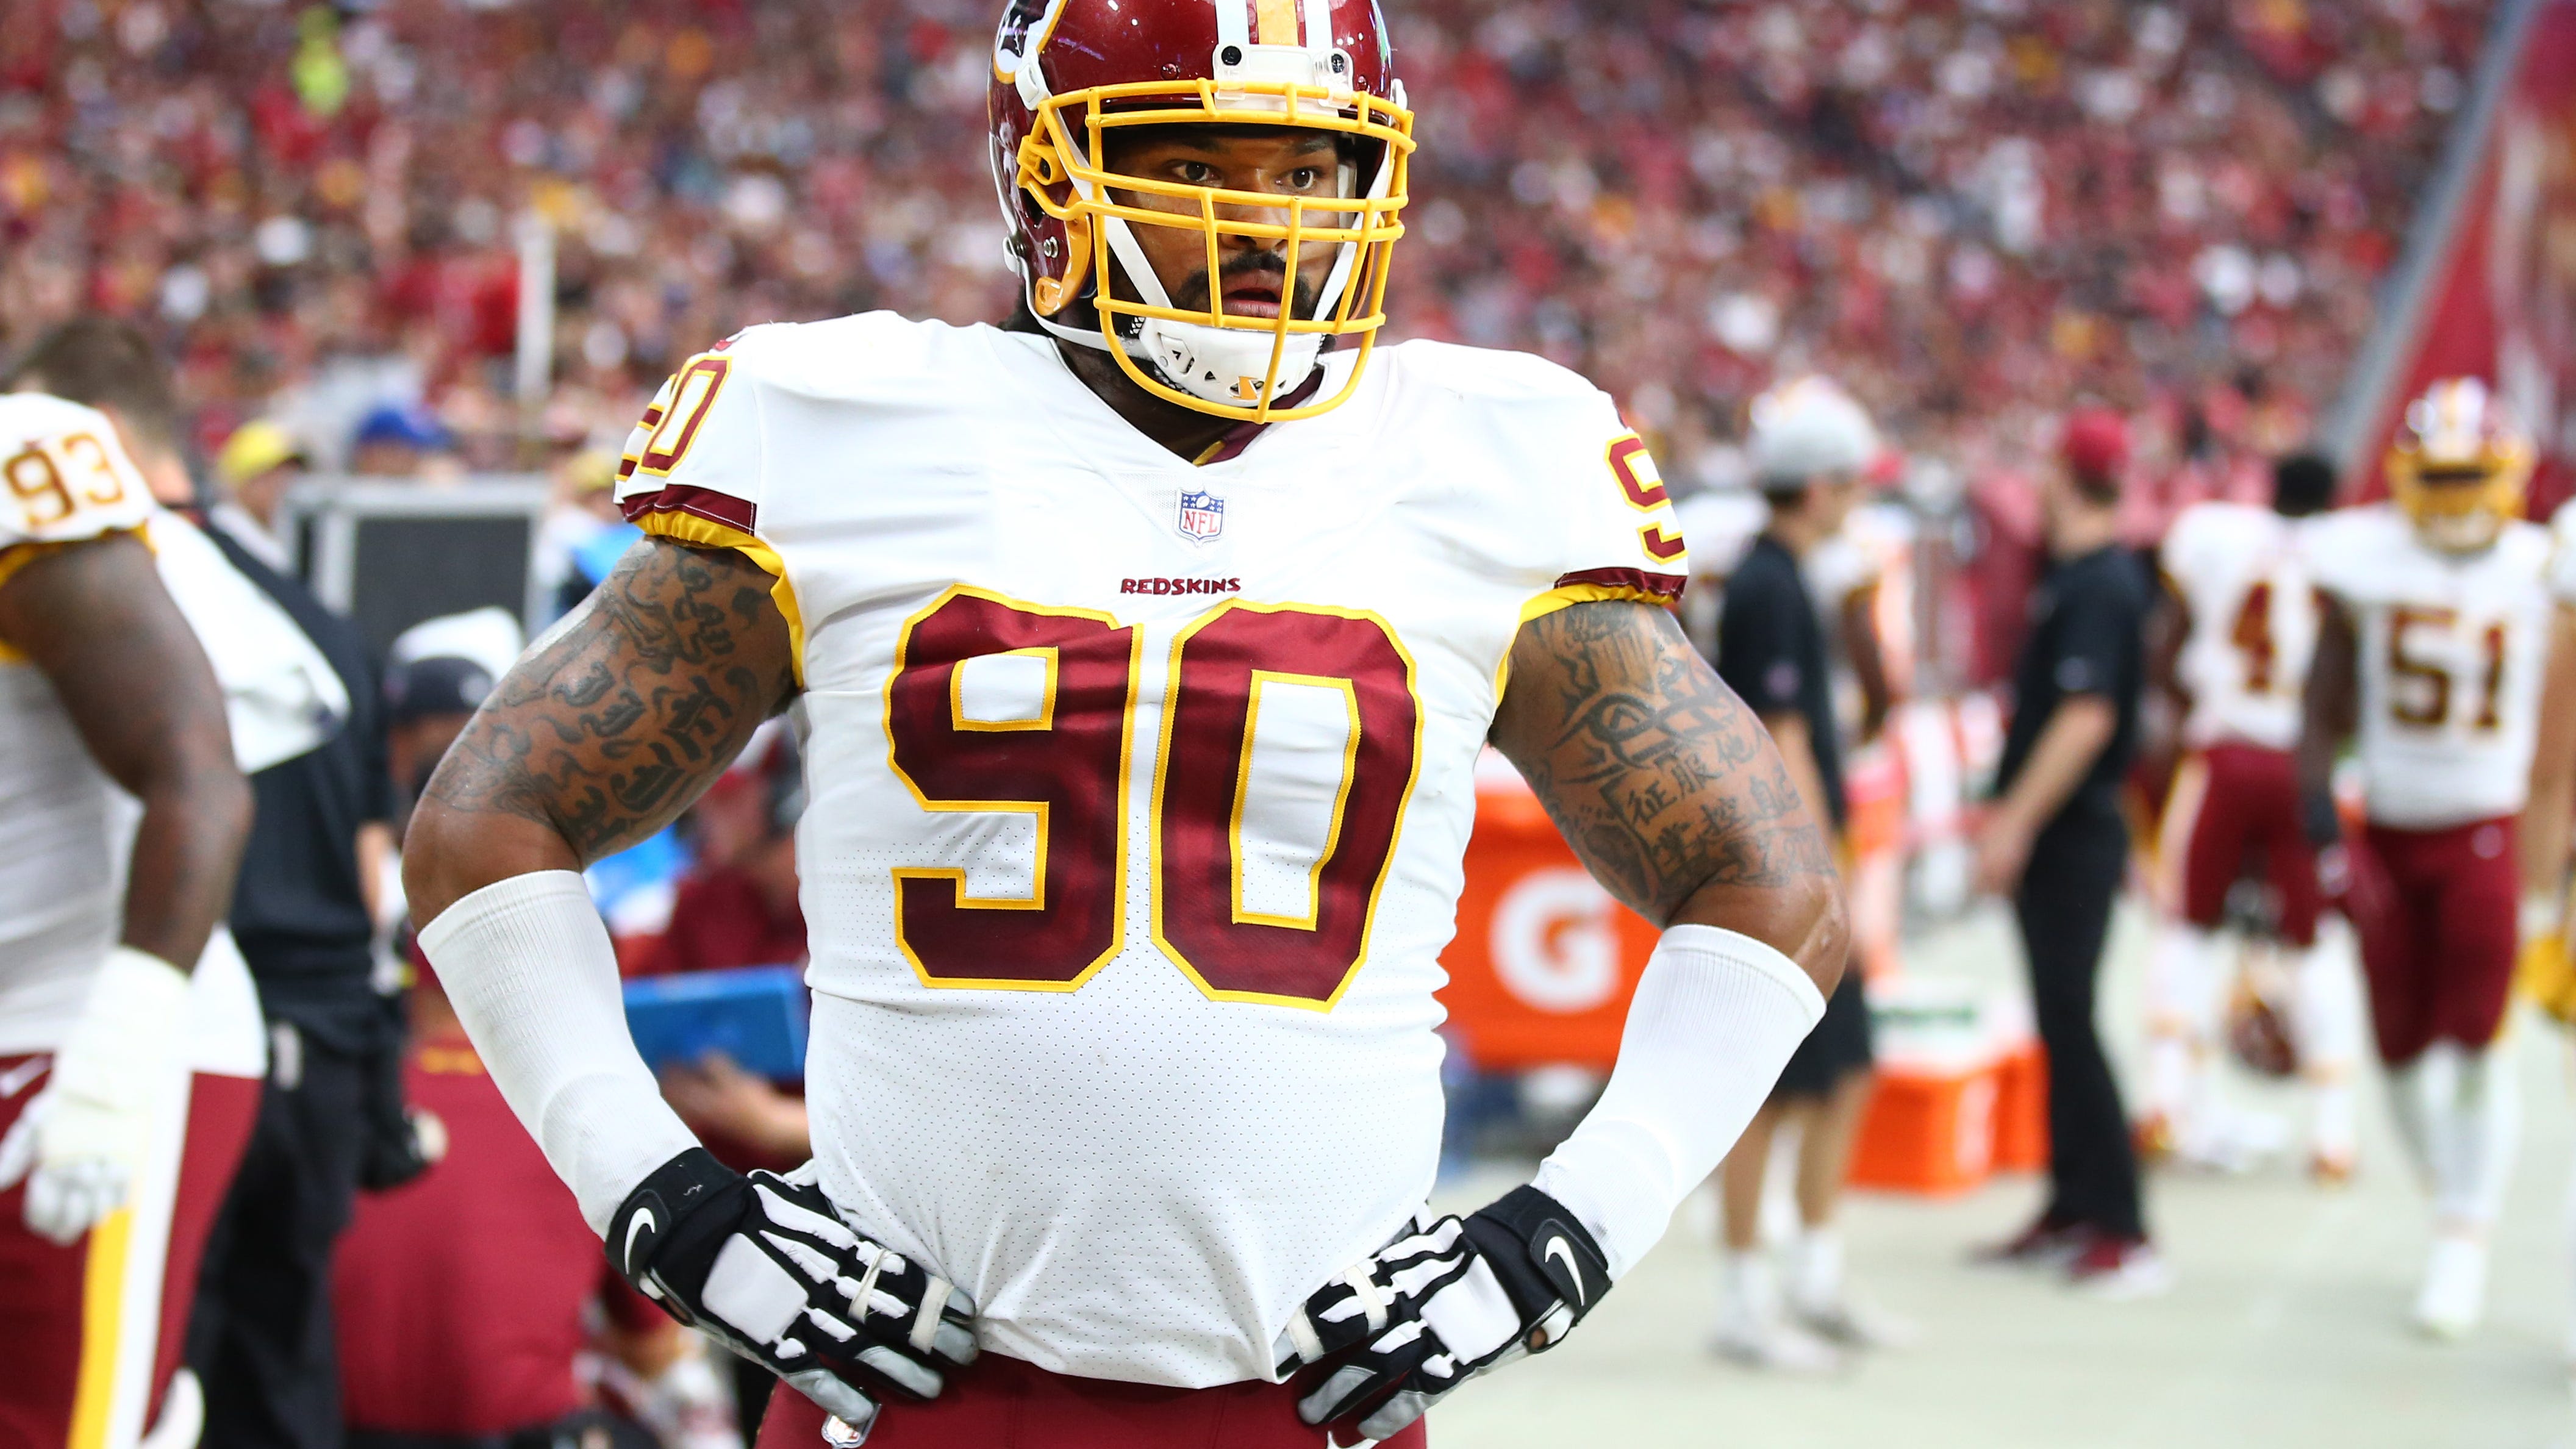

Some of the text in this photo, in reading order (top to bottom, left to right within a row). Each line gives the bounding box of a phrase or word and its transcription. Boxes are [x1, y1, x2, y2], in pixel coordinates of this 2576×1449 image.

[2, 431, 126, 528] 93
[1182, 510, 1218, 534] NFL
[1120, 577, 1242, 596] REDSKINS
[2386, 604, 2506, 733] 51
[882, 582, 1423, 1012] 90
[1489, 865, 1622, 1015] G
